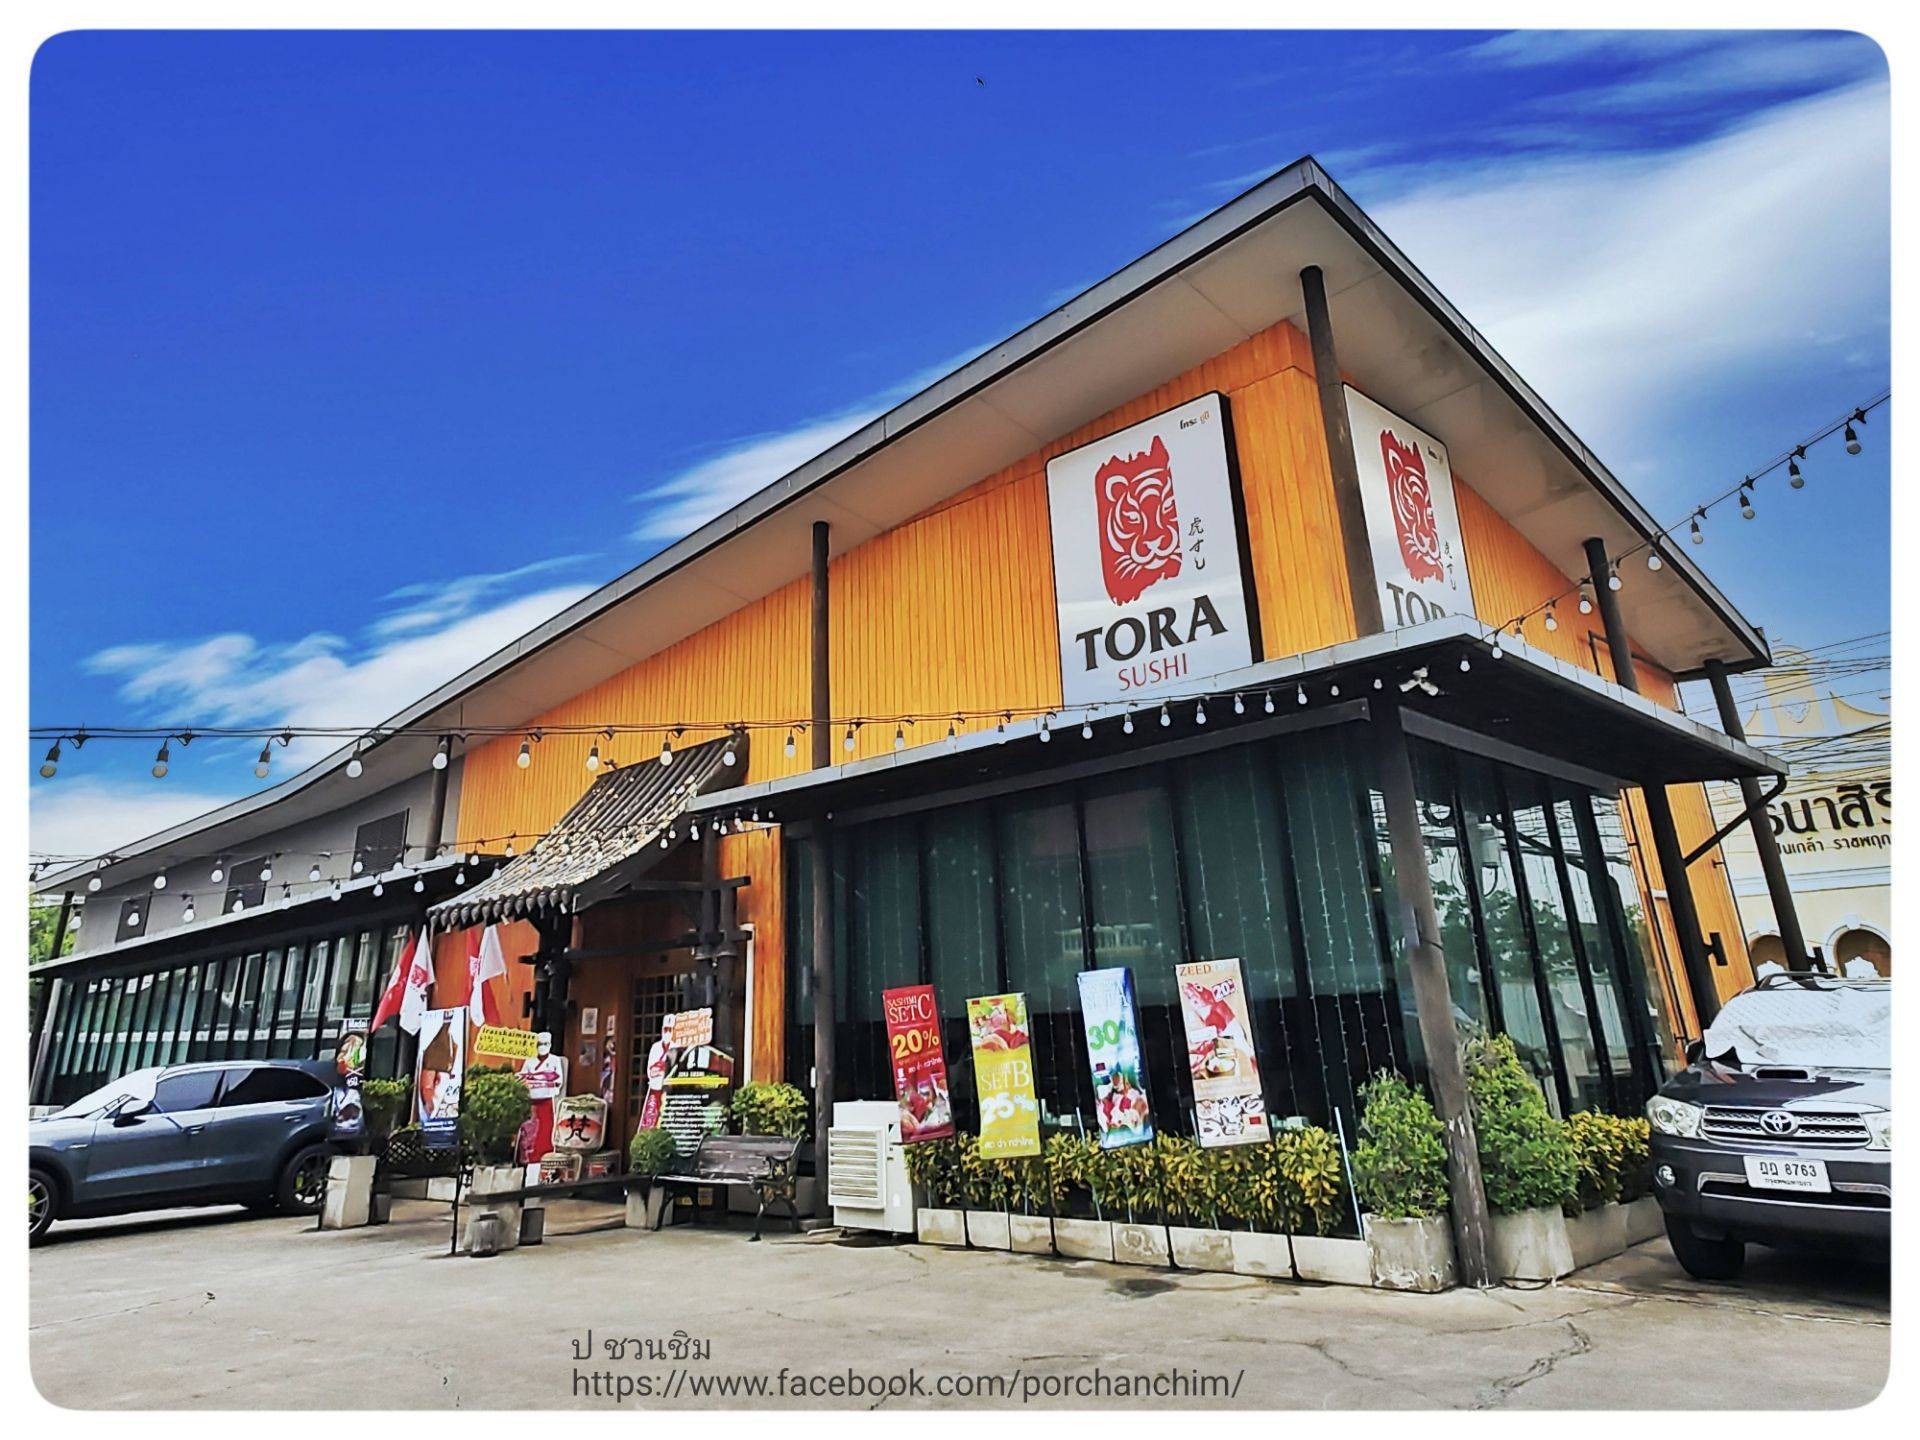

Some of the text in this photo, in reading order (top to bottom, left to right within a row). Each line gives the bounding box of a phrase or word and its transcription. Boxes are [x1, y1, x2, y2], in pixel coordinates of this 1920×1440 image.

[1075, 594, 1228, 671] TORA
[1118, 652, 1188, 691] SUSHI
[1180, 963, 1212, 977] ZEED
[889, 1004, 918, 1024] SET
[892, 1027, 940, 1060] 20%
[981, 1092, 1036, 1126] 25%
[1785, 1163, 1817, 1177] 8763
